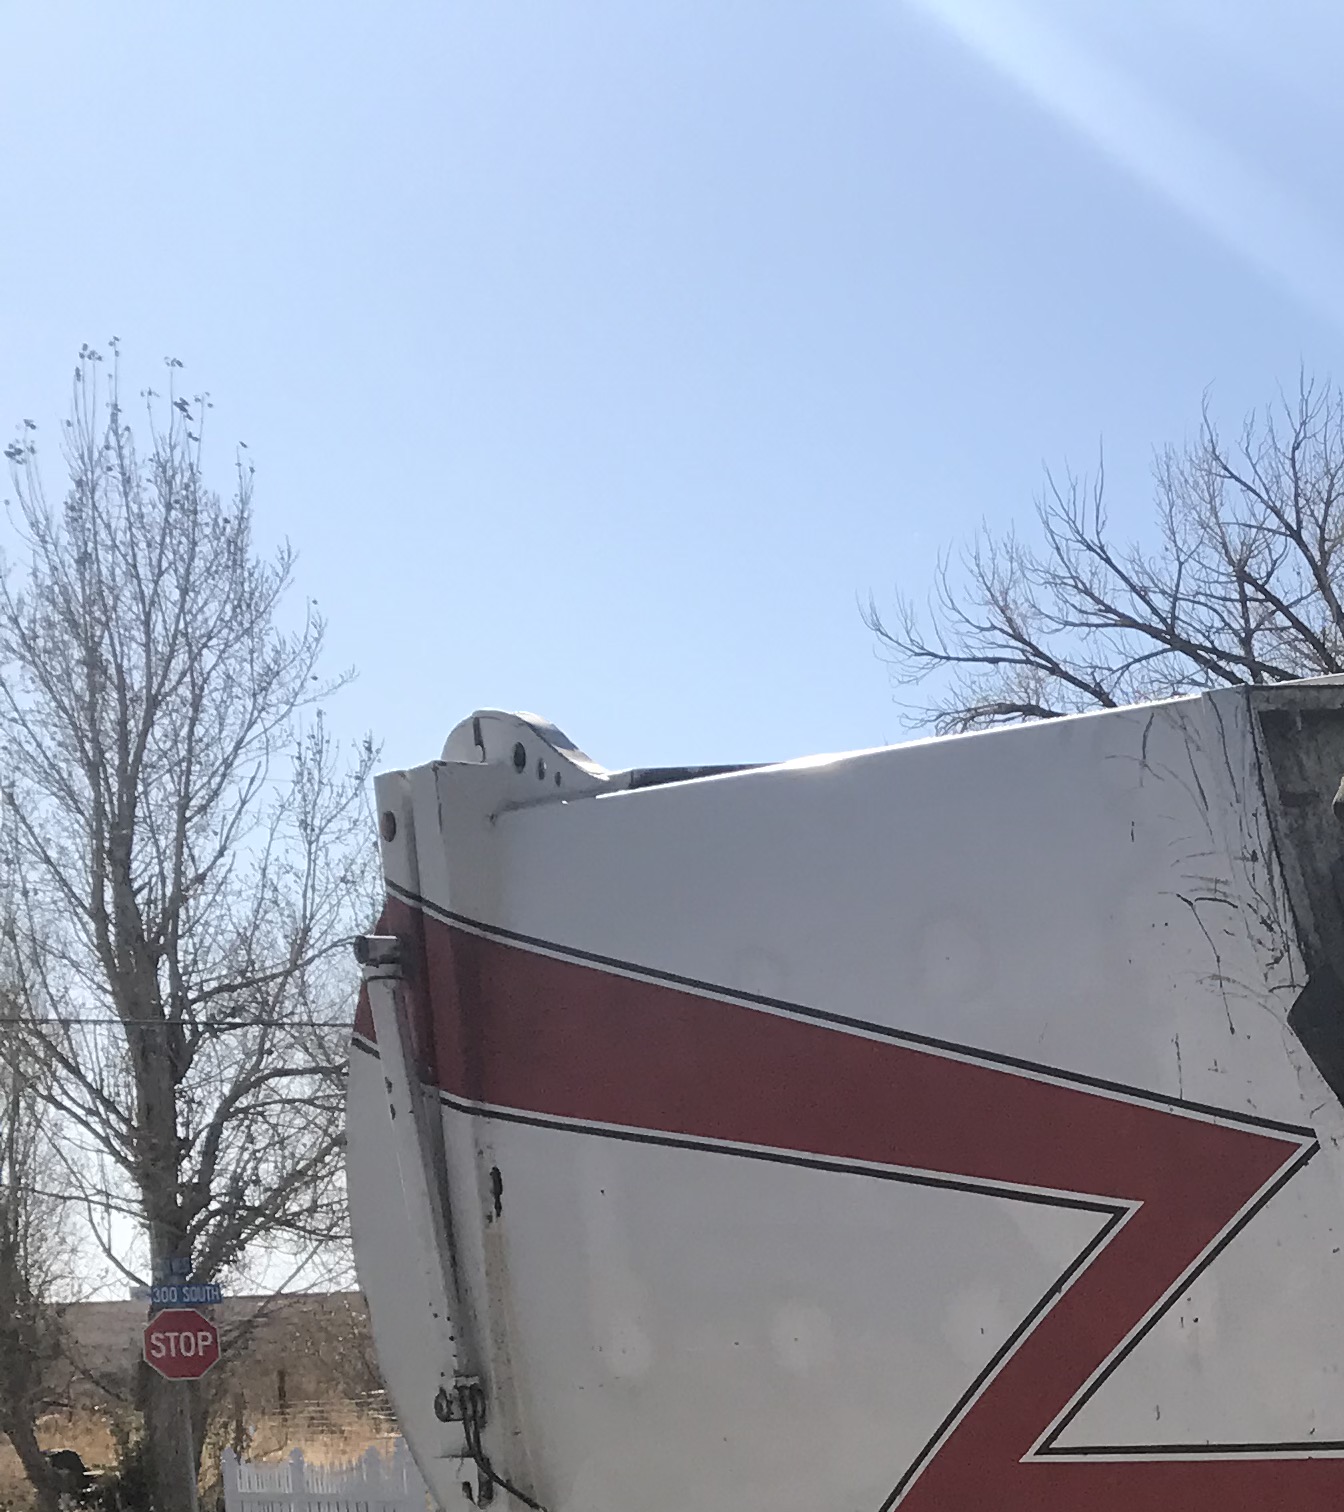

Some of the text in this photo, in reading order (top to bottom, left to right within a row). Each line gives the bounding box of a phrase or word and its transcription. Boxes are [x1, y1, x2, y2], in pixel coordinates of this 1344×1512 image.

[153, 1285, 221, 1303] 300 SOUTH
[150, 1331, 213, 1358] STOP
